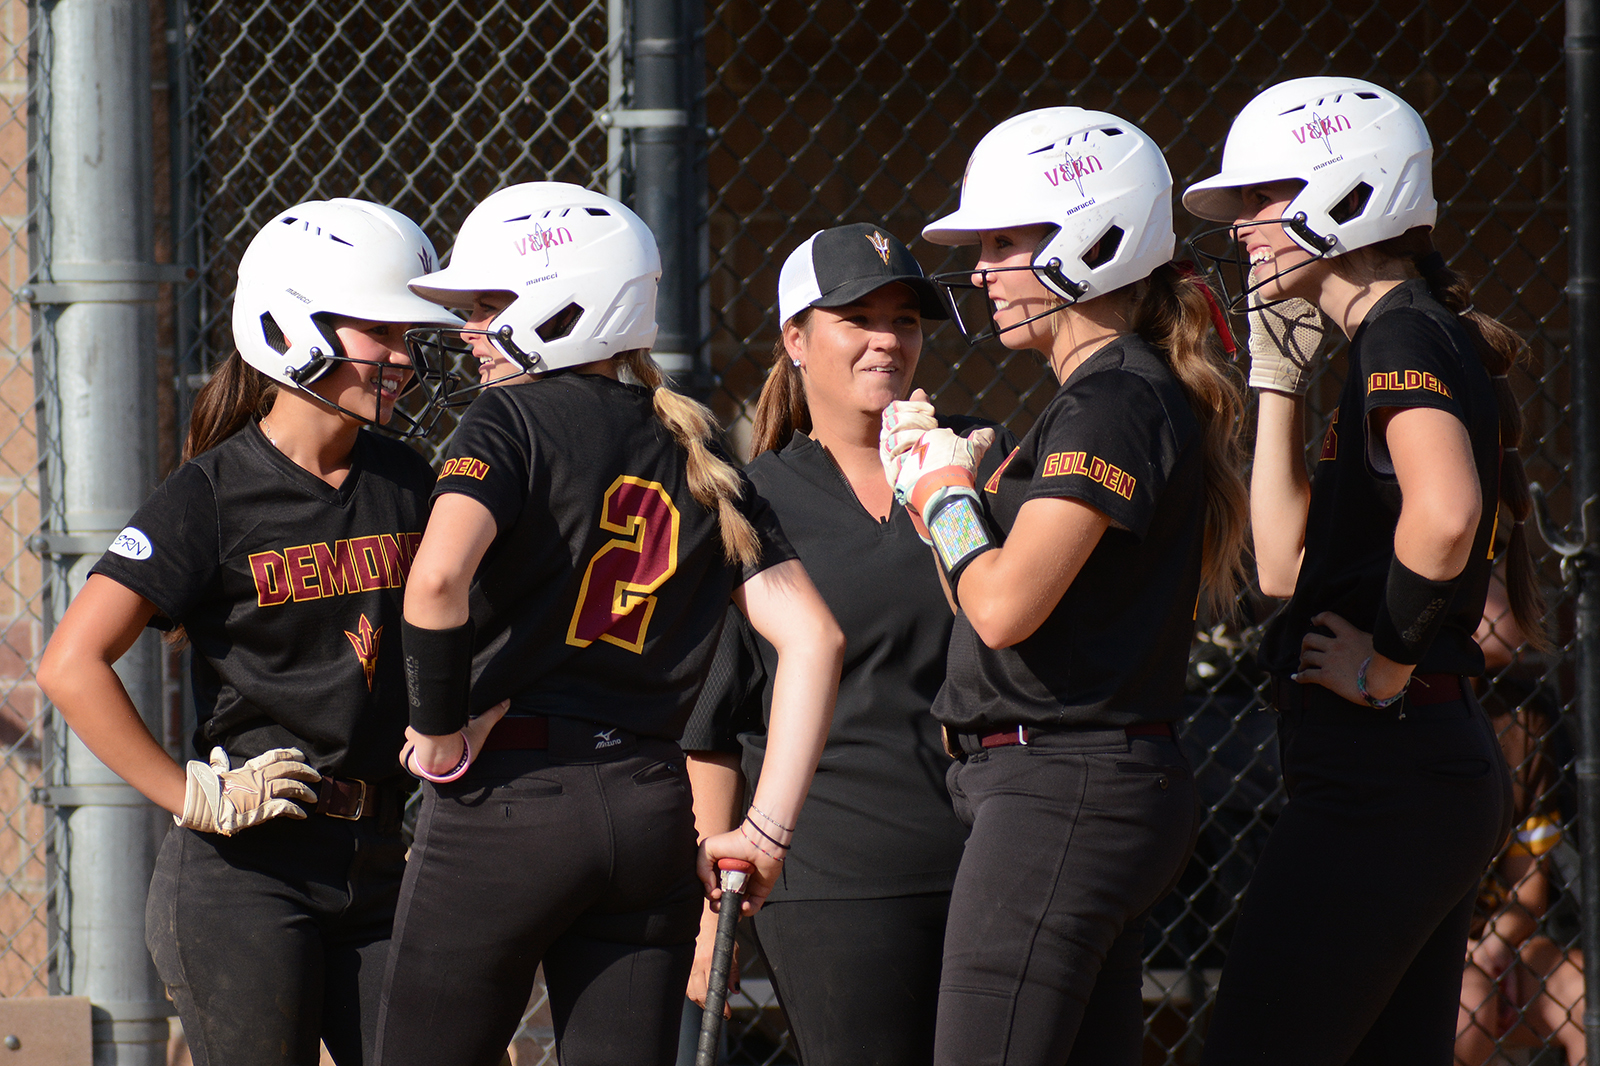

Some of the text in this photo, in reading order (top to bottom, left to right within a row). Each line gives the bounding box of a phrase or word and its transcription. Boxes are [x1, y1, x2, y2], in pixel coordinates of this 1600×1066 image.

[1313, 154, 1344, 171] marucci
[1066, 197, 1096, 216] marucci
[525, 271, 558, 286] marucci
[1366, 369, 1453, 400] OLDEN
[438, 456, 491, 481] DEN
[1042, 451, 1137, 501] GOLDEN
[565, 474, 680, 655] 2
